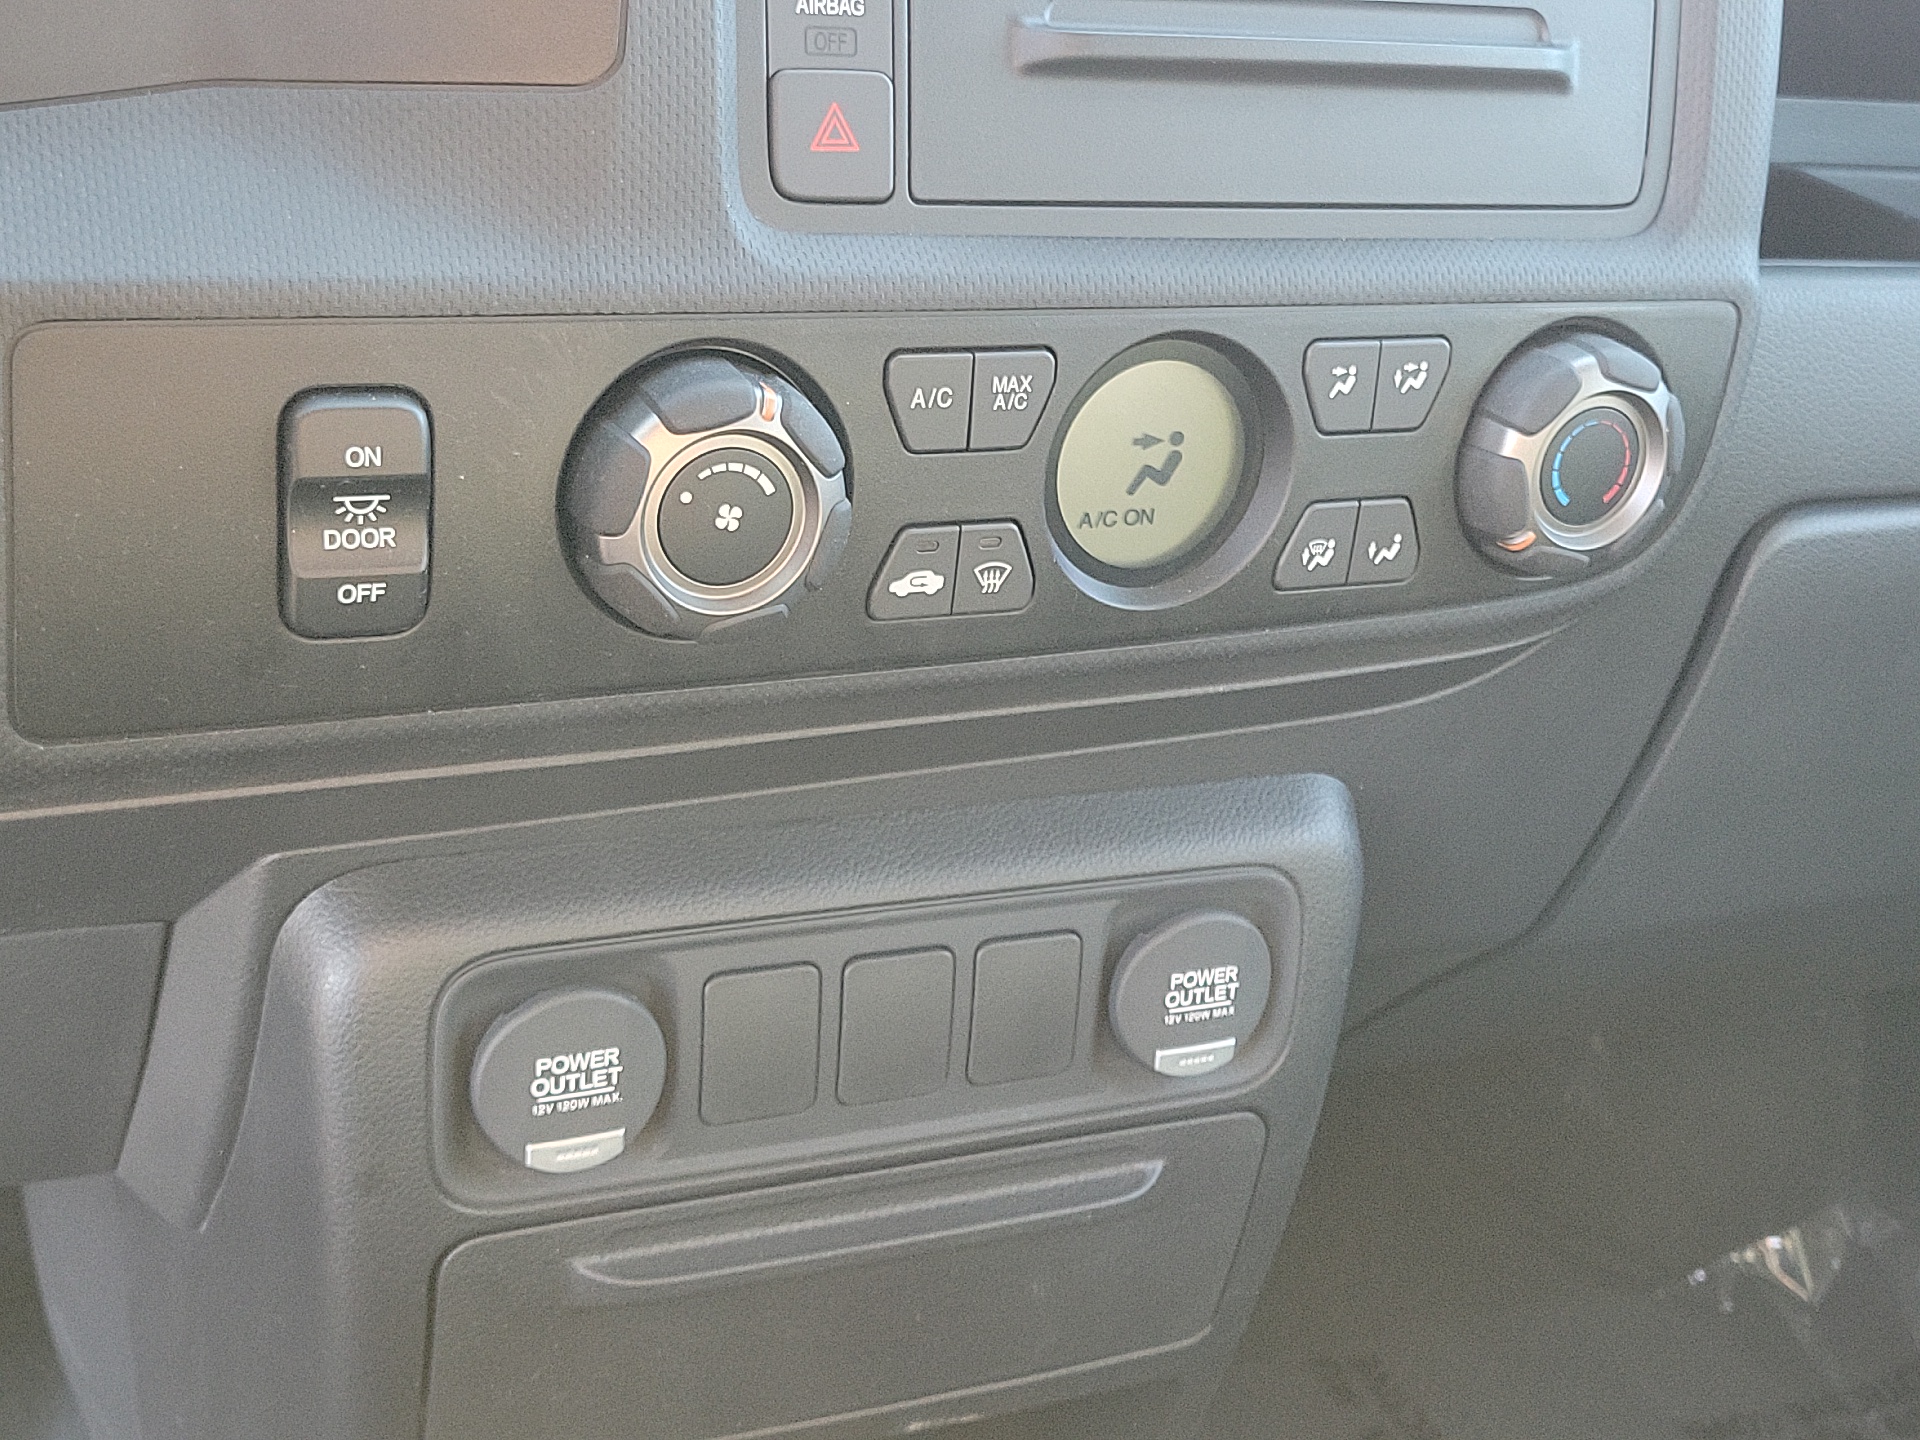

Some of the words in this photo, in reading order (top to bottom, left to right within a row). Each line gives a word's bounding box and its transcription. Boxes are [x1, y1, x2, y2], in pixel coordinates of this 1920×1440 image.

[795, 0, 865, 17] AIRBAG
[814, 32, 848, 52] OFF
[992, 375, 1033, 393] MAX
[910, 387, 953, 409] A/C
[992, 393, 1028, 411] A/C
[345, 446, 382, 467] ON
[1078, 510, 1118, 529] A/C
[1124, 508, 1155, 526] ON
[323, 527, 396, 550] DOOR
[337, 582, 387, 604] OFF
[1170, 965, 1239, 990] POWER
[1164, 982, 1239, 1009] OUTLET
[535, 1047, 620, 1077] POWER
[530, 1066, 623, 1098] OUTLET
[532, 1103, 554, 1116] 12V
[556, 1097, 590, 1113] 120W
